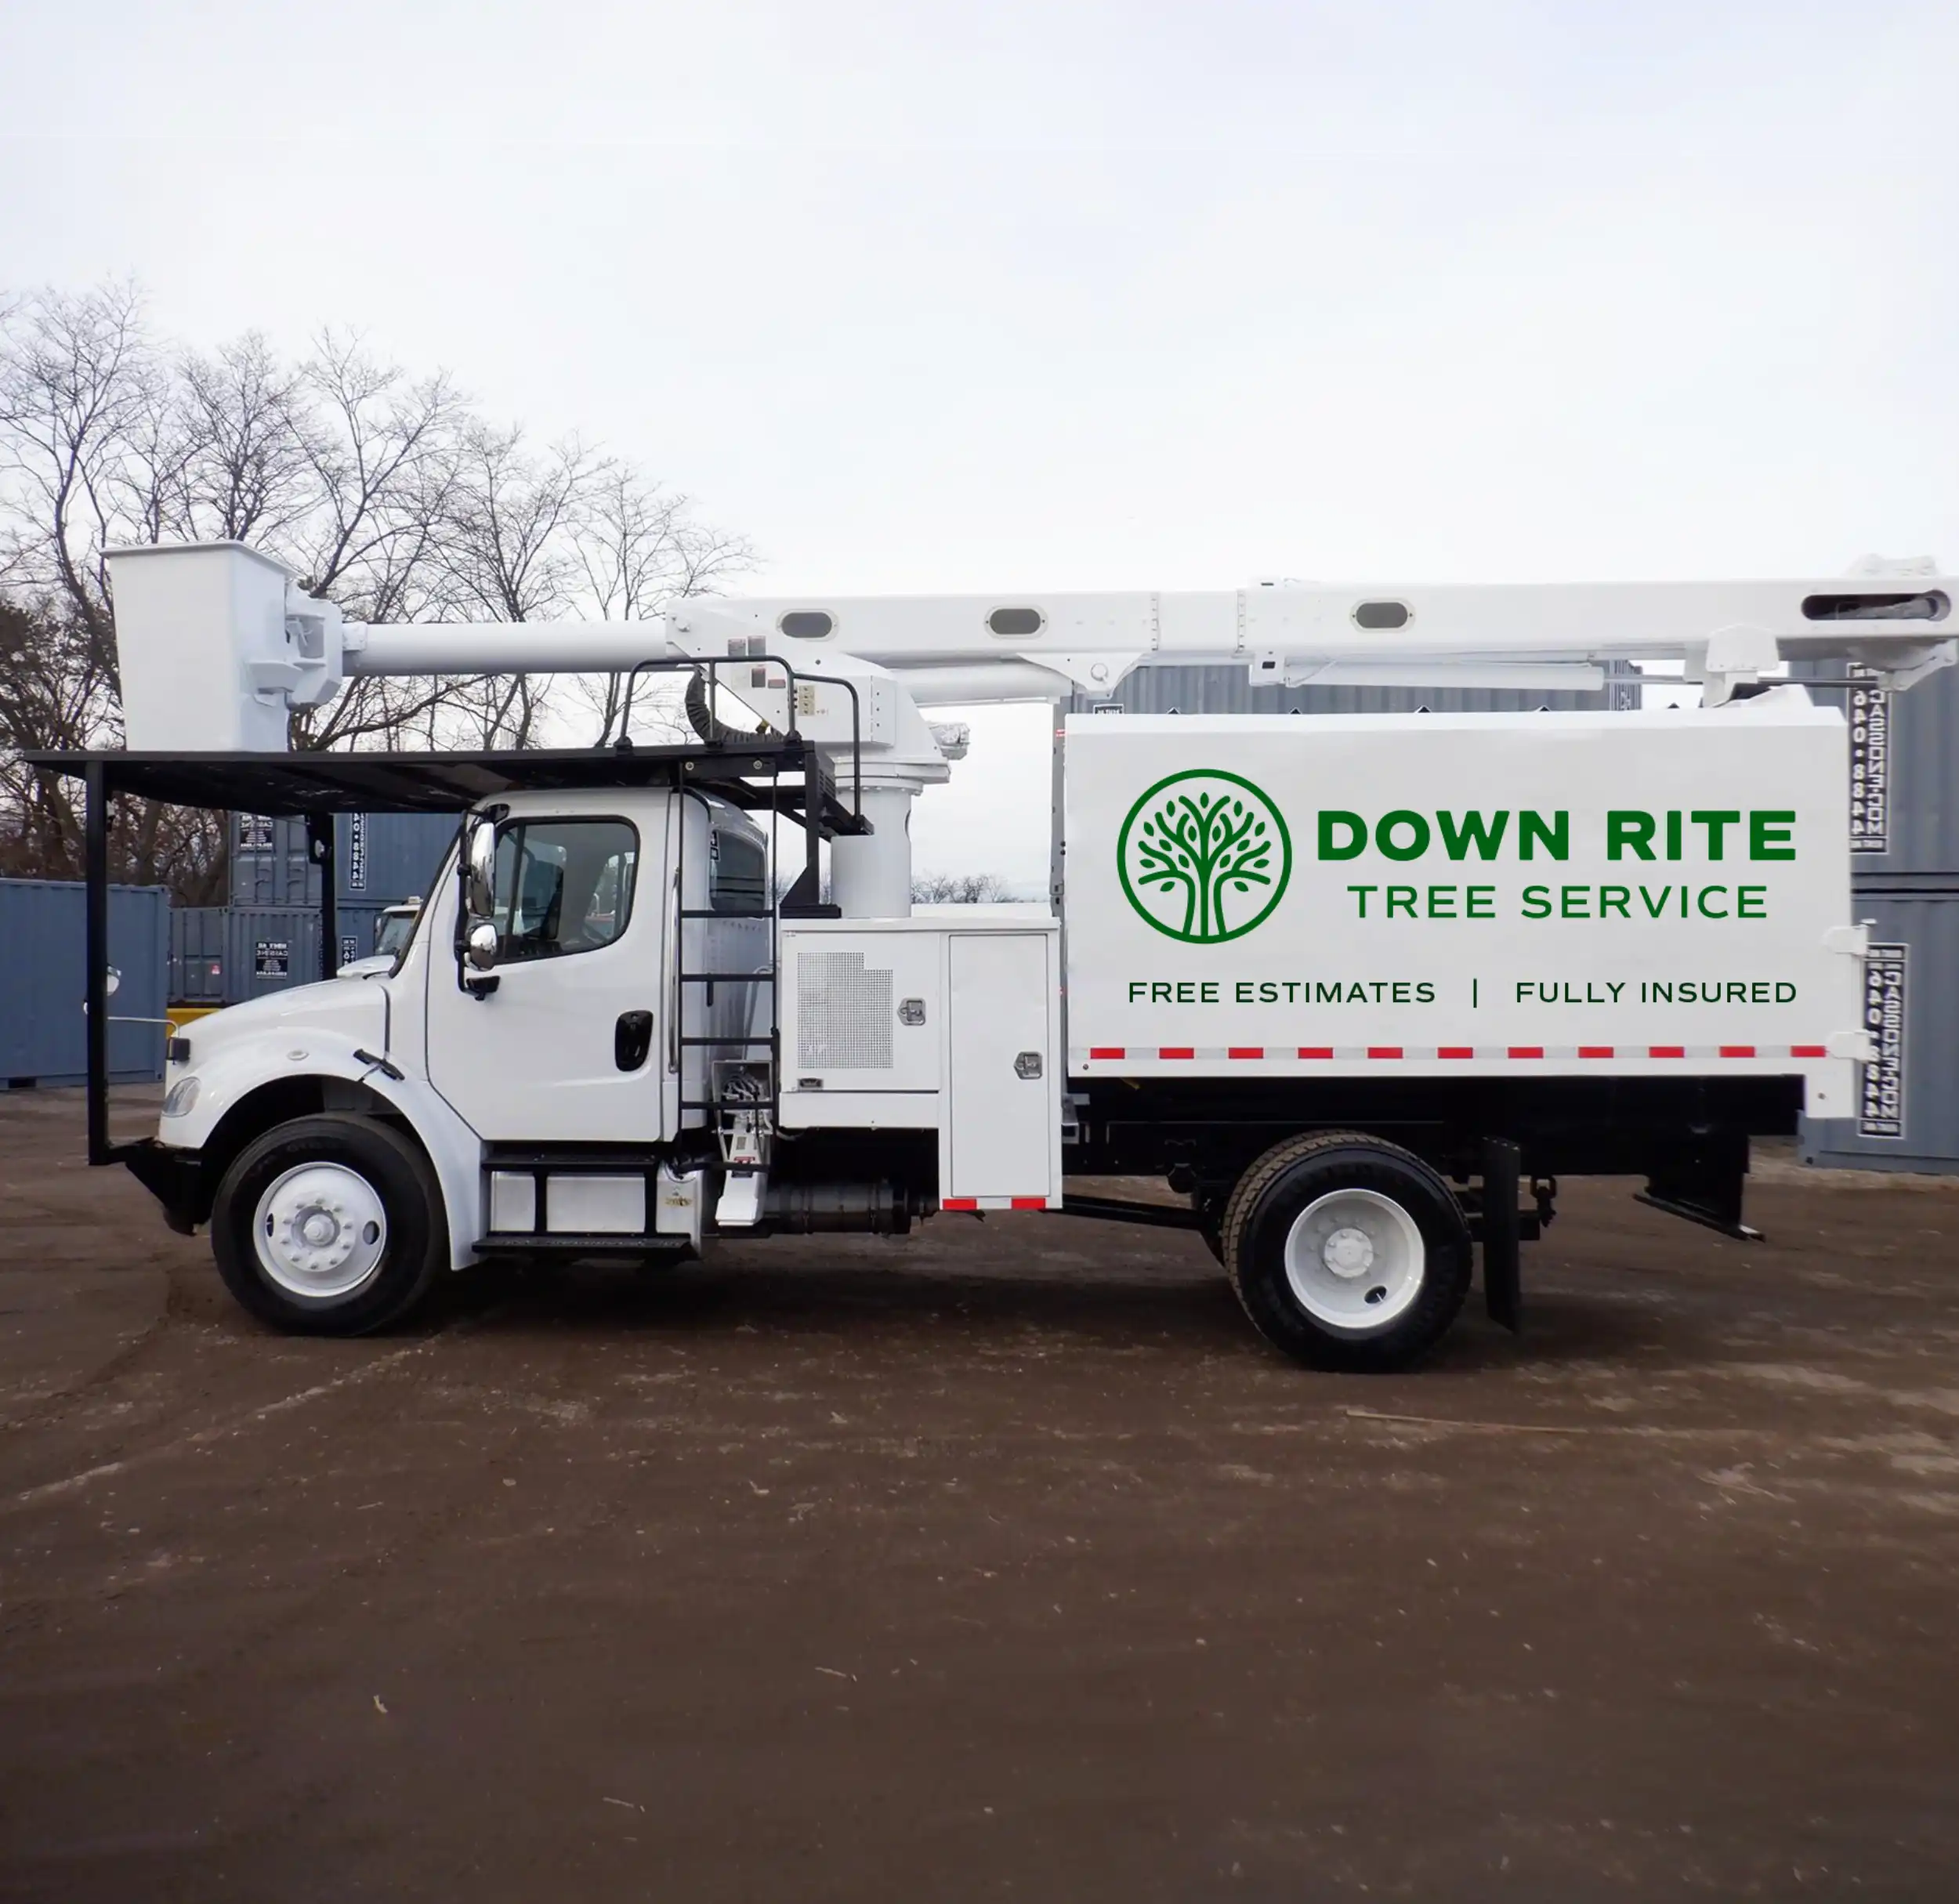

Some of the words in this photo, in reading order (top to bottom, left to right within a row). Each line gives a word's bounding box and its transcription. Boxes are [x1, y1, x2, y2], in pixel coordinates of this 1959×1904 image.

[1318, 810, 1569, 861] DOWN
[1607, 811, 1795, 860] RITE
[1347, 886, 1495, 918] TREE
[1522, 885, 1766, 918] SERVICE
[1129, 983, 1219, 1002] FREE
[1237, 983, 1435, 1003] ESTIMATES
[1517, 983, 1625, 1002] FULLY
[1642, 983, 1796, 1002] INSURED
